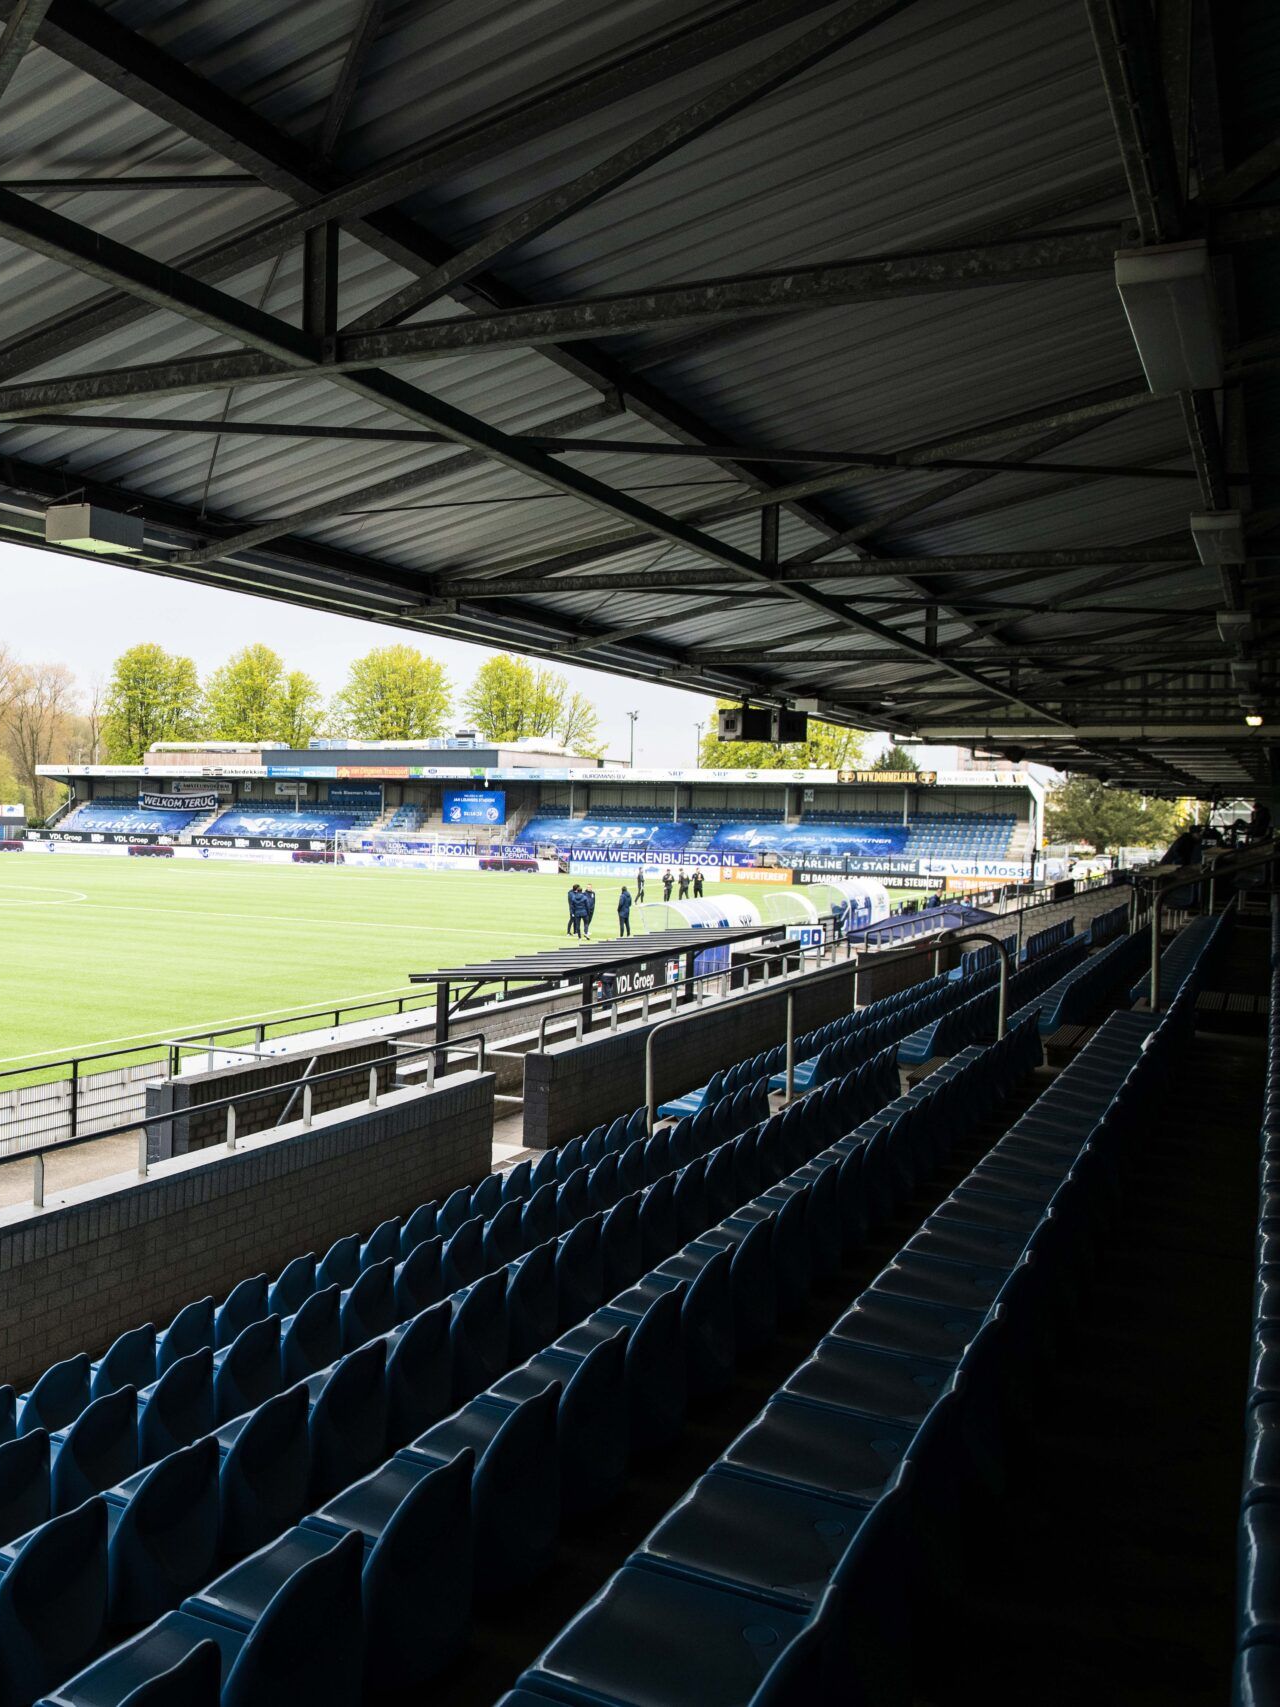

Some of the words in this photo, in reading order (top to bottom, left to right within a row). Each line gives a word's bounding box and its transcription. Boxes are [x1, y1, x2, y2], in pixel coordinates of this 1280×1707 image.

[144, 795, 182, 807] WELKOM
[183, 795, 214, 807] TERUG
[83, 821, 161, 830] STARLINE
[49, 833, 63, 841] VDL
[64, 833, 82, 842] Groep
[578, 826, 646, 838] SRP
[113, 835, 128, 843] VDL
[129, 836, 148, 844] Groep
[195, 838, 210, 846] VDL
[211, 838, 232, 847] Groep
[260, 840, 276, 848] VDL
[277, 840, 299, 850] Groep
[571, 850, 739, 867] WWW.WERKENBIJEDCO.NL
[791, 858, 842, 869] STARLINE
[863, 860, 917, 872] STARLINE
[951, 864, 979, 874] Van
[984, 865, 1039, 877] Mossel
[800, 873, 810, 882] EN
[904, 878, 944, 888] STEUNEN?
[616, 974, 632, 994] VDL
[633, 972, 655, 990] Groep
